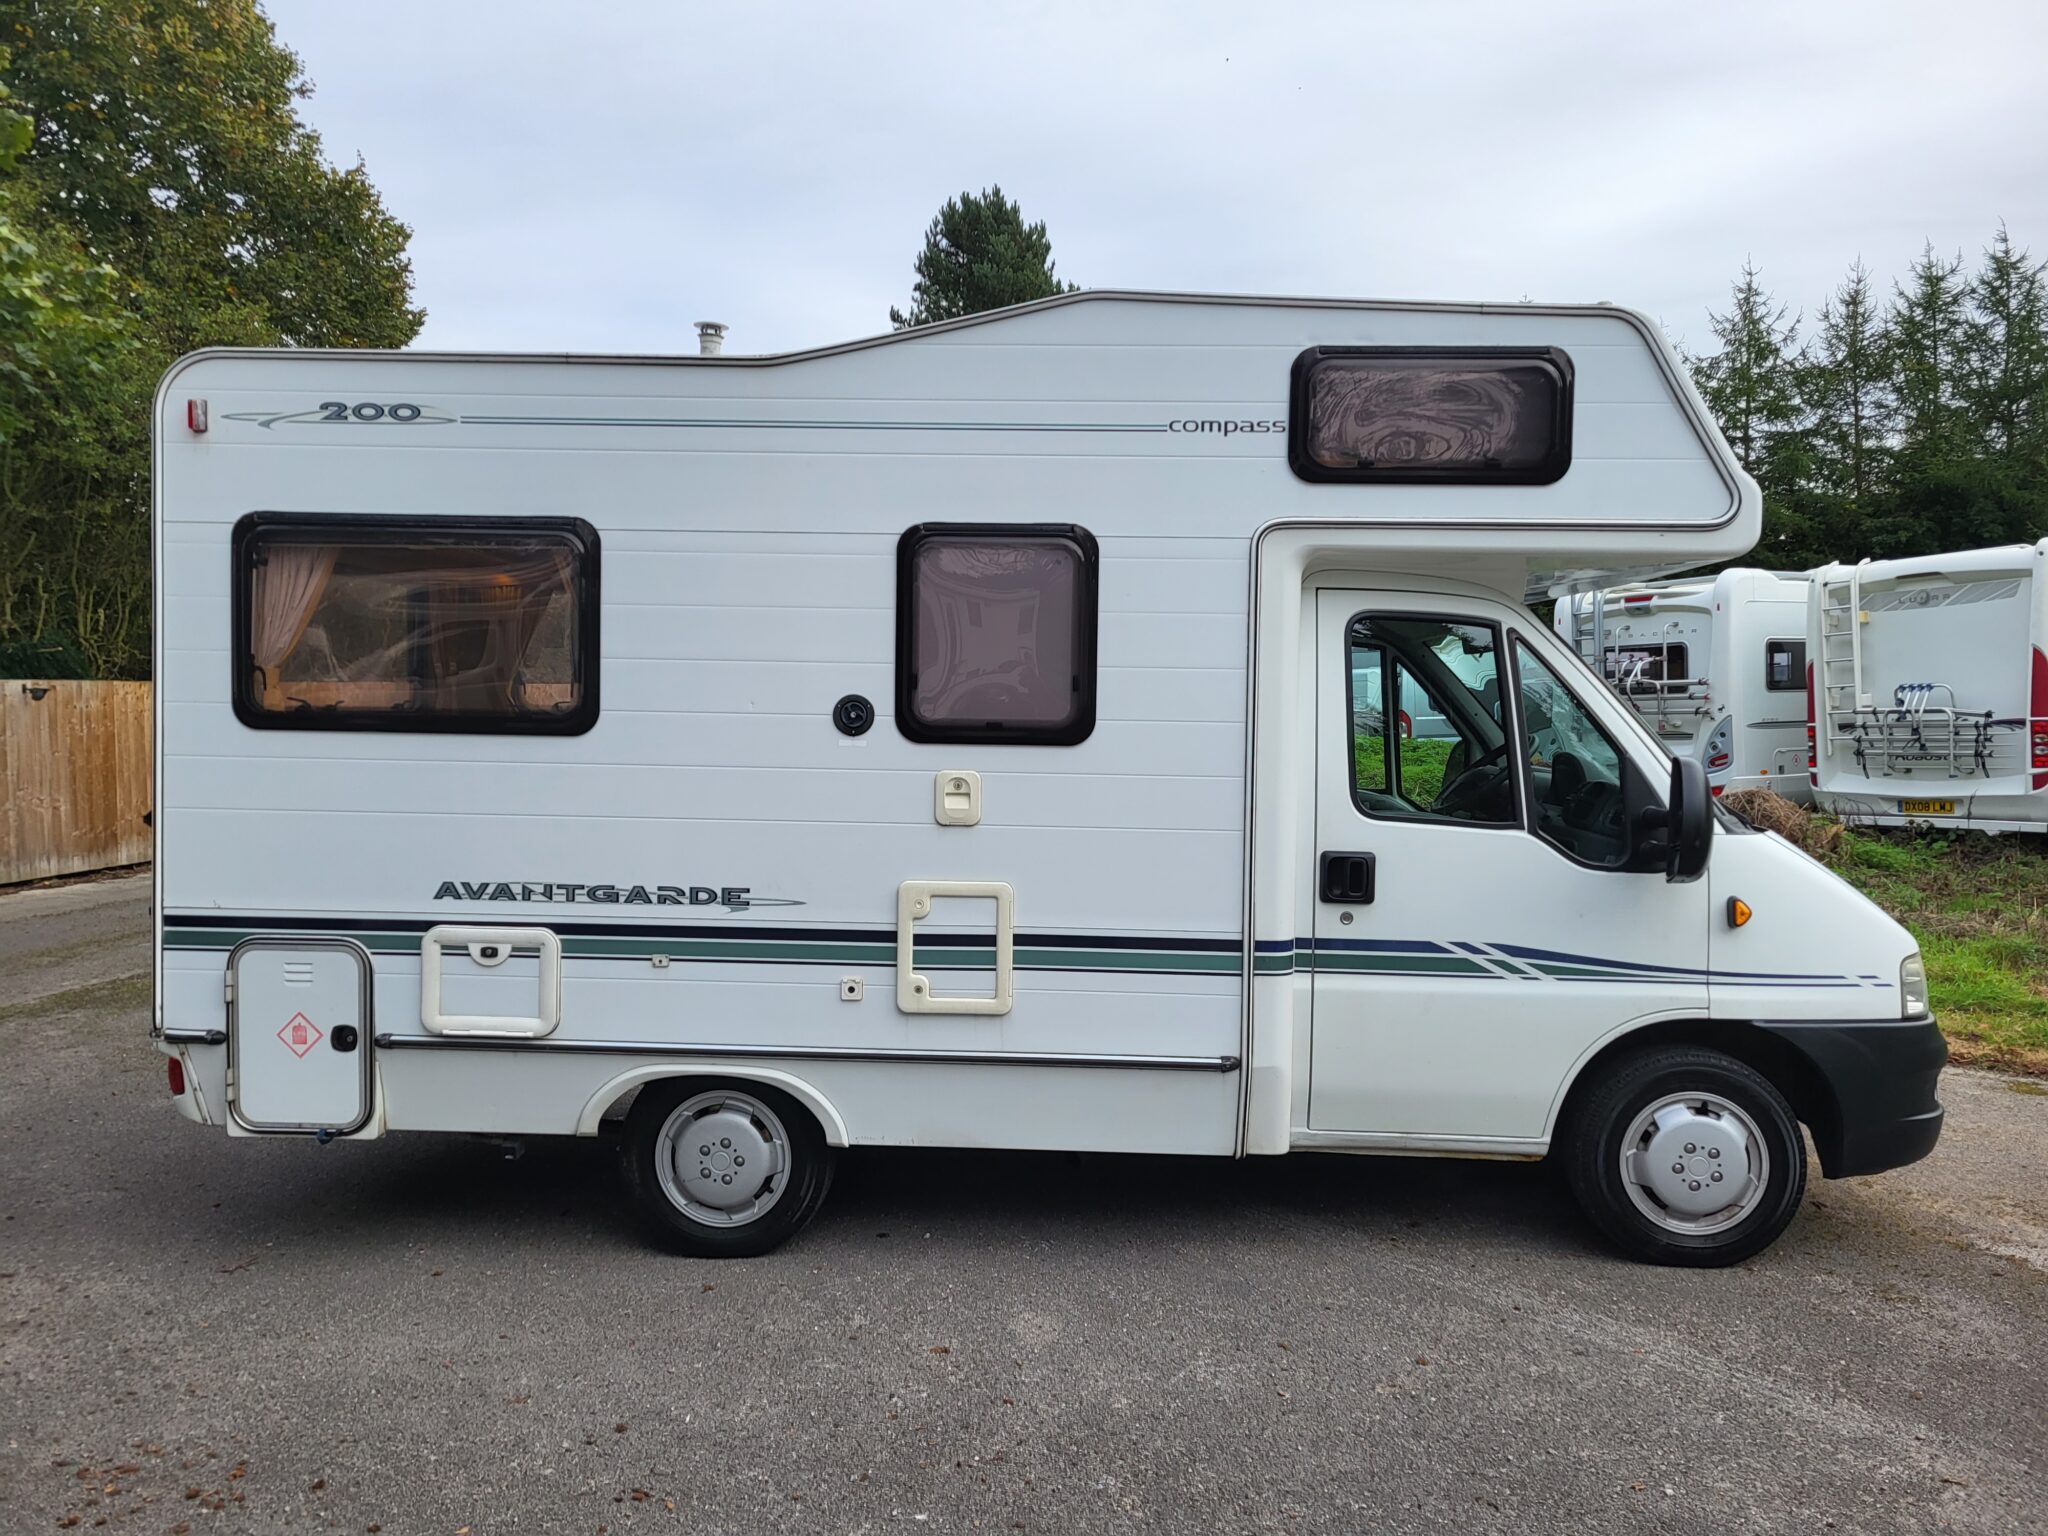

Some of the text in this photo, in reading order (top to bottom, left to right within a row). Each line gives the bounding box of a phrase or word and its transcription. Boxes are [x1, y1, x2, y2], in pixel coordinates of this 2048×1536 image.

[319, 402, 421, 421] 200
[1169, 419, 1286, 437] compass
[1904, 801, 1930, 812] DX08
[433, 881, 750, 907] AVANTGARDE
